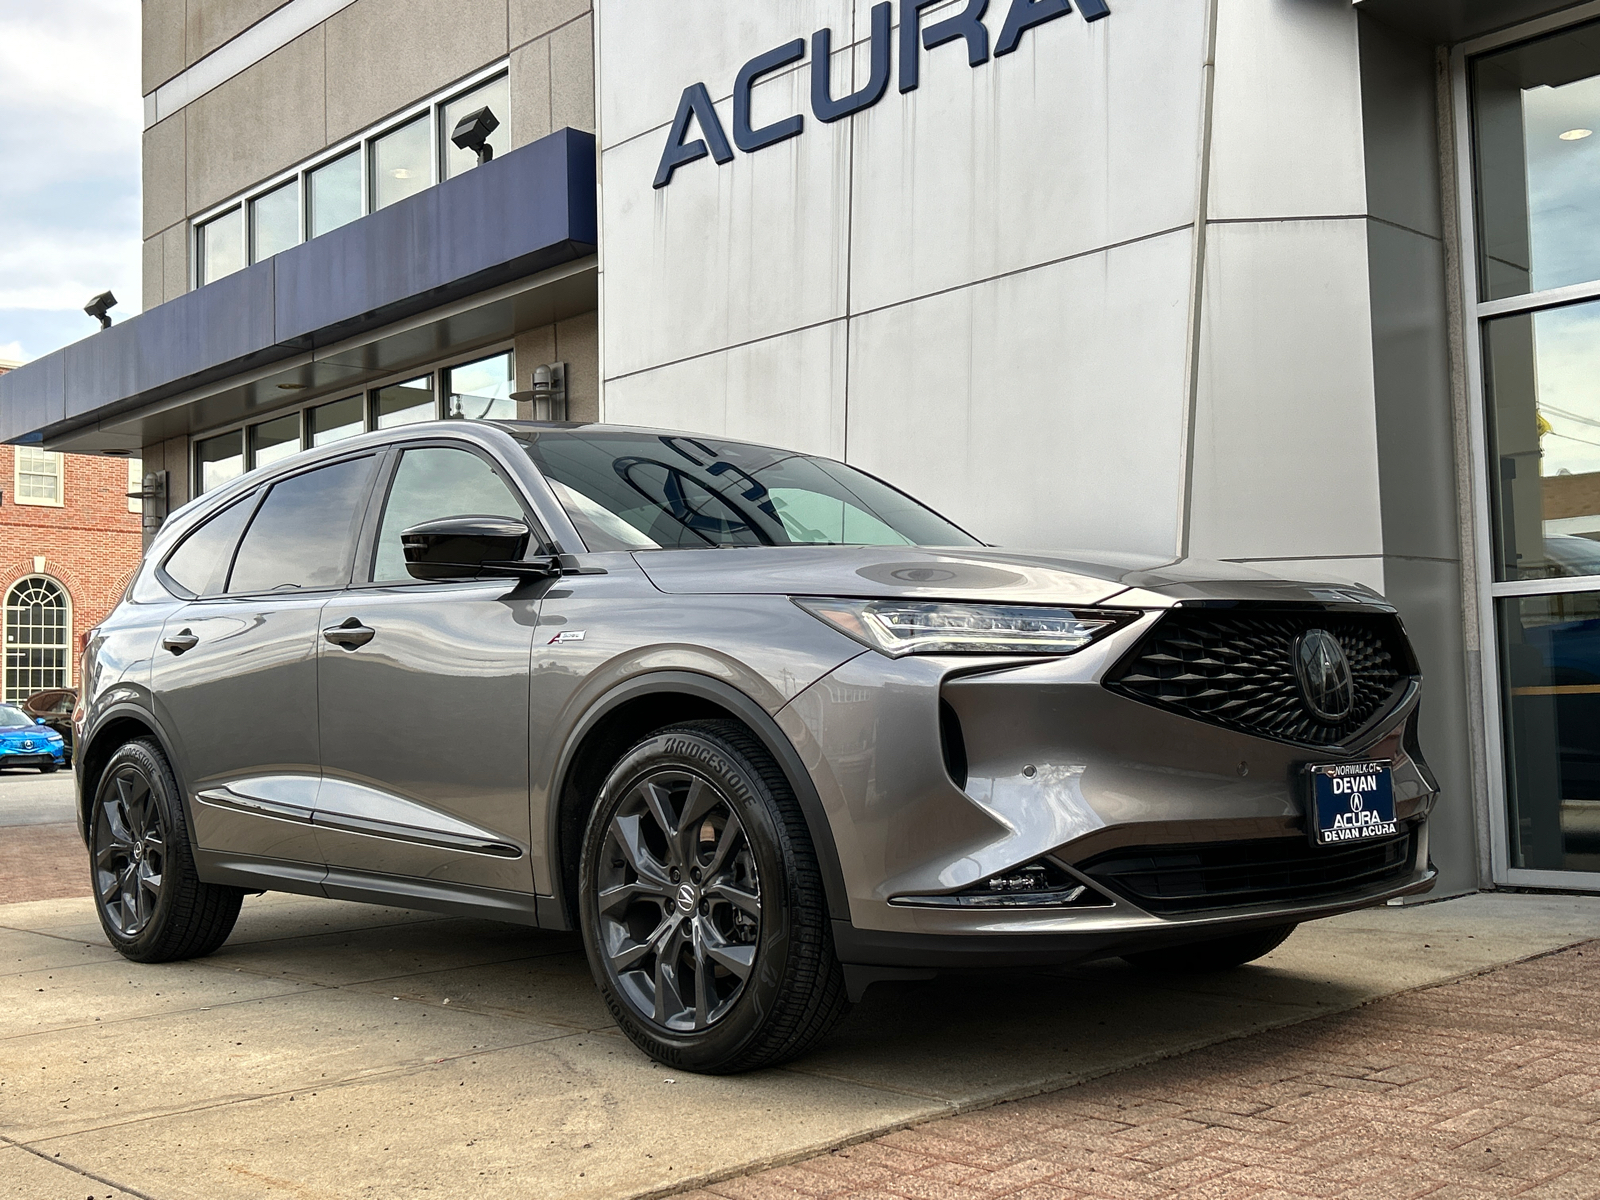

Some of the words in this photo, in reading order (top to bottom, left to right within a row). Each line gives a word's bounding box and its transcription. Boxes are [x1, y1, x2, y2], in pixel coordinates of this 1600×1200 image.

[663, 737, 758, 810] BRIDGESTONE
[1332, 775, 1377, 794] DEVAN
[1333, 810, 1380, 828] ACURA
[1324, 828, 1360, 842] DEVAN
[1361, 823, 1397, 837] ACURA
